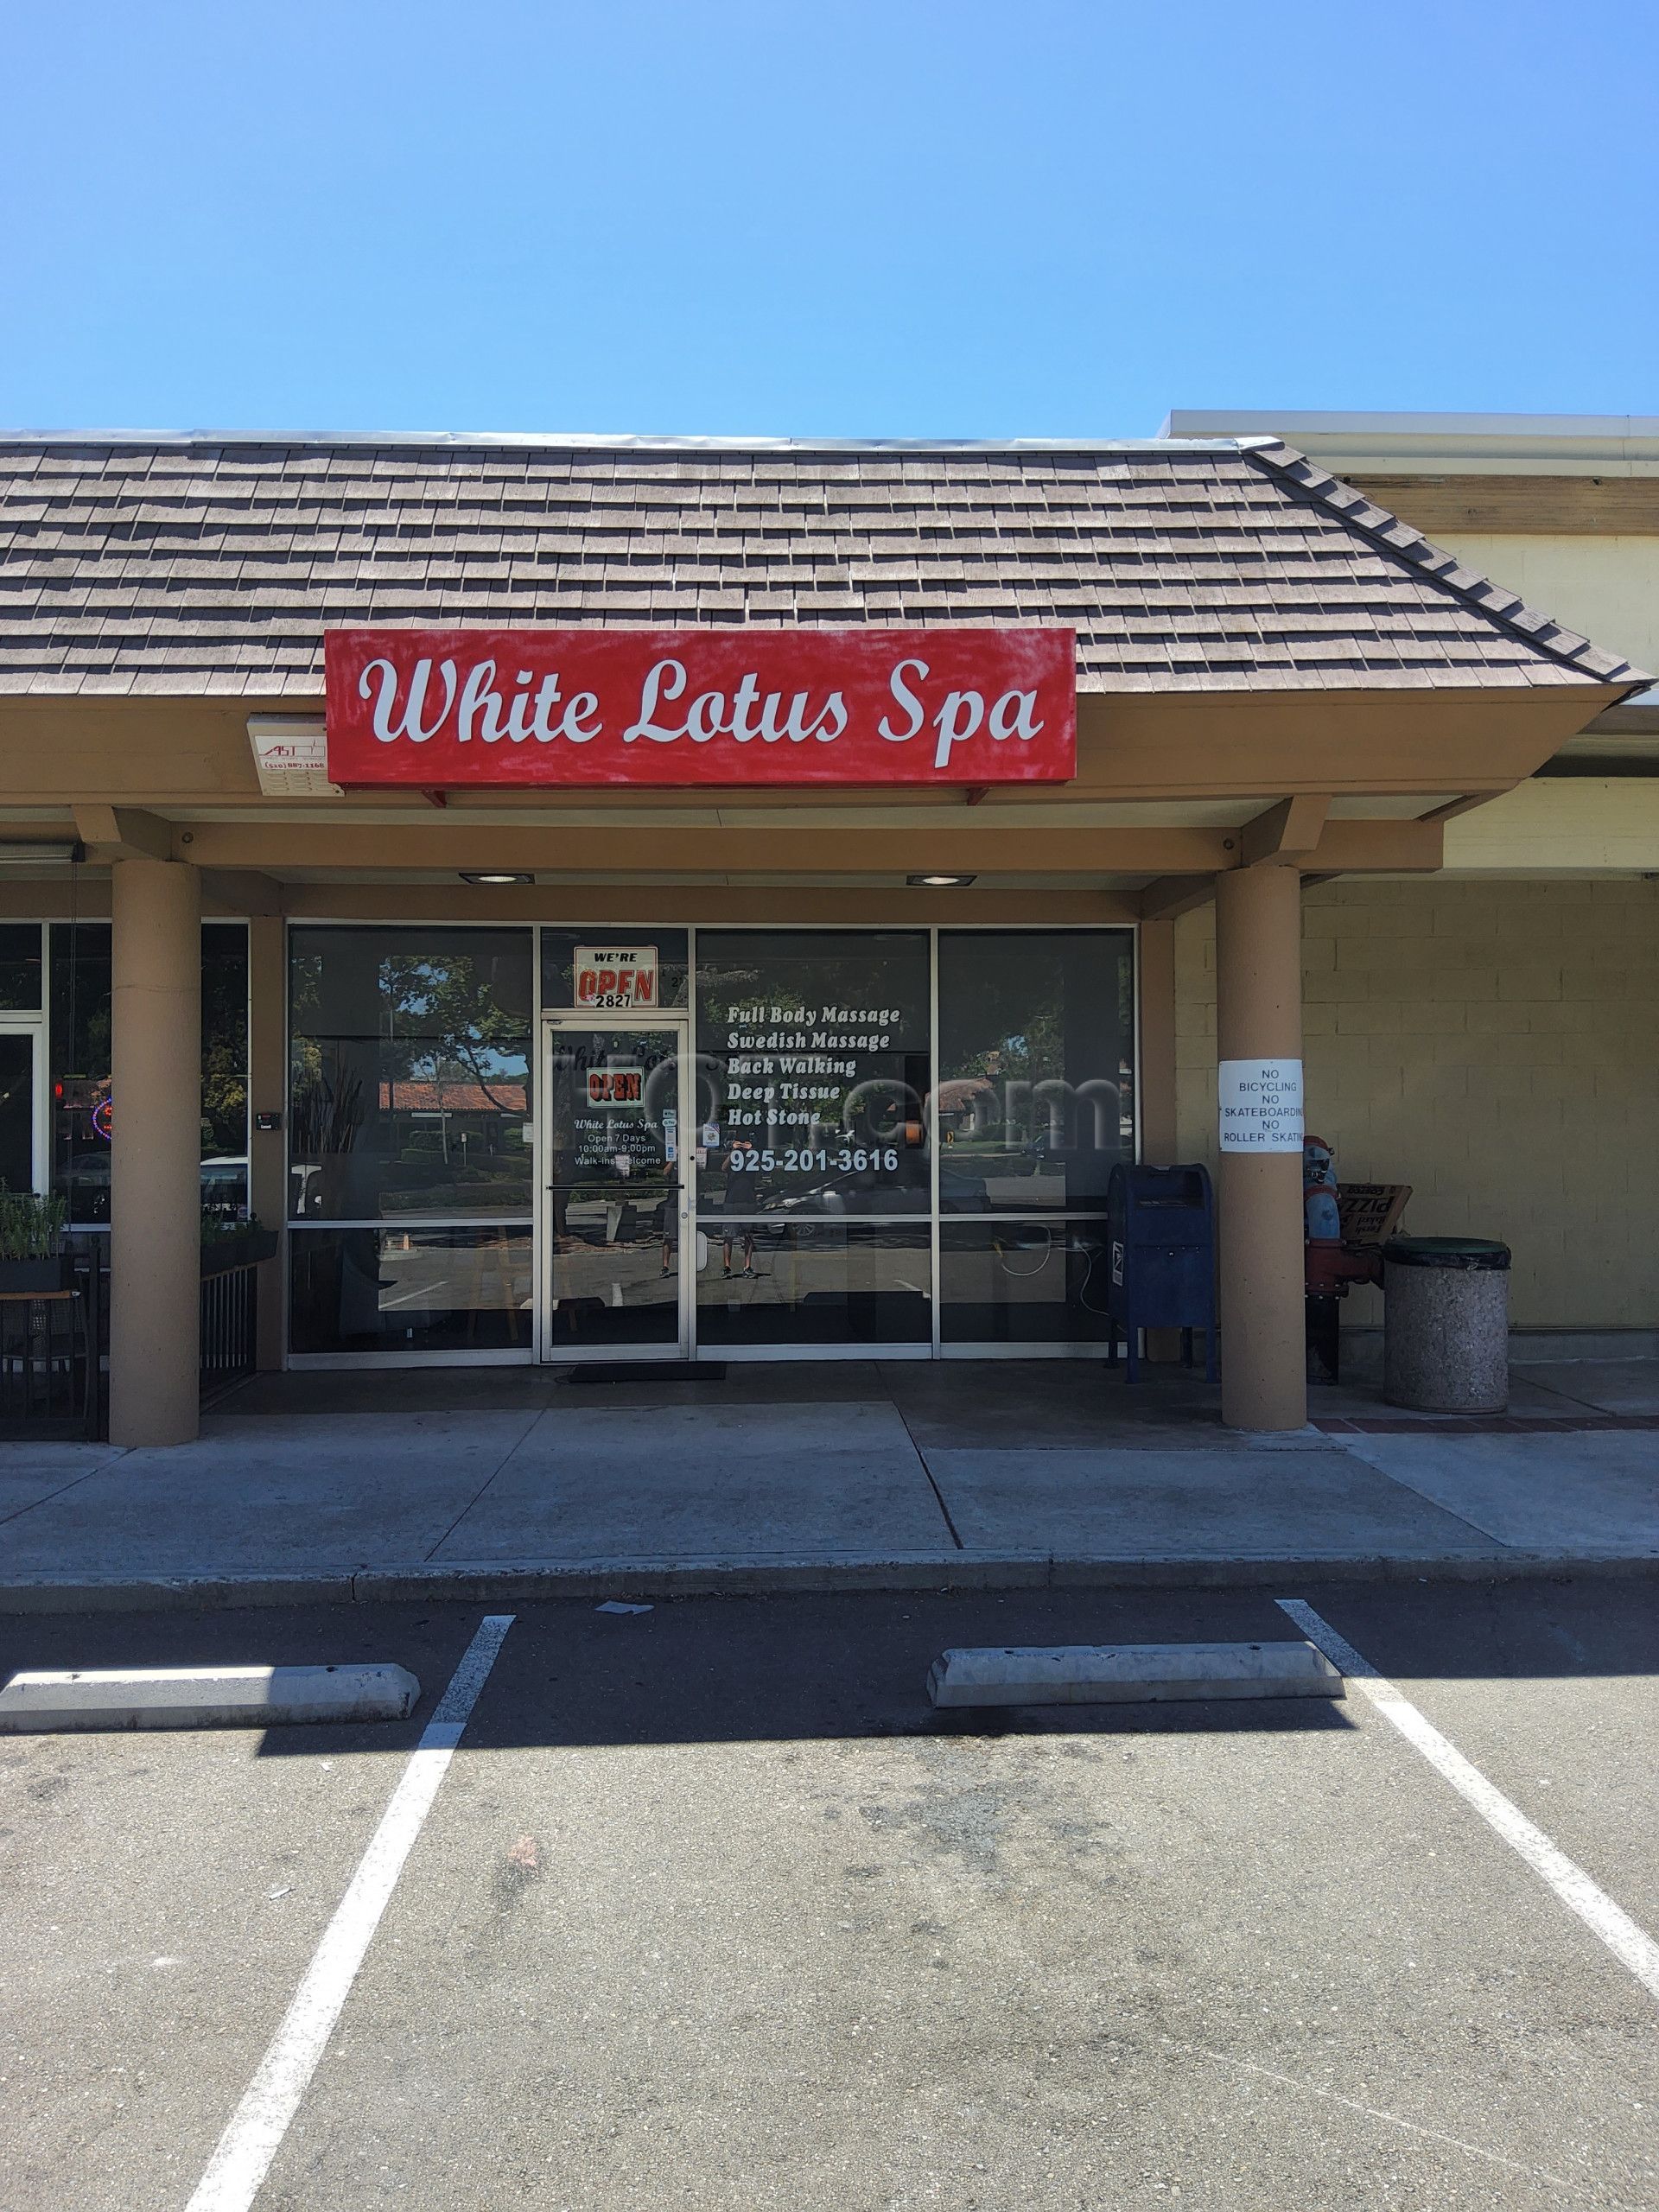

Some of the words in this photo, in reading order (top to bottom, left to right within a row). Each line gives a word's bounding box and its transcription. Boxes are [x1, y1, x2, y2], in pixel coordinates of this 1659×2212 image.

[359, 658, 603, 743] White
[623, 658, 849, 743] Lotus
[878, 658, 1045, 769] Spa
[594, 953, 638, 962] WE'RE
[579, 969, 654, 1001] OPEN
[595, 995, 631, 1007] 2827
[728, 1007, 765, 1023] Full
[770, 1007, 817, 1027] Body
[822, 1007, 900, 1026] Massage
[728, 1032, 806, 1049] Swedish
[810, 1033, 890, 1052] Massage
[728, 1058, 774, 1075] Back
[779, 1058, 856, 1077] Walking
[1262, 1070, 1279, 1079] NO
[589, 1073, 642, 1101] OPEN
[1239, 1082, 1297, 1091] BICYCLING
[728, 1084, 775, 1103] Deep
[780, 1083, 840, 1099] Tissue
[1262, 1095, 1279, 1104] NO
[728, 1109, 762, 1126] Hot
[766, 1109, 821, 1125] Stone
[1224, 1108, 1303, 1116] SKATEBOARDIN
[575, 1119, 604, 1129] White
[607, 1119, 634, 1129] Lotus
[638, 1119, 658, 1131] Spa
[1262, 1120, 1280, 1130] NO
[588, 1135, 613, 1144] Open
[623, 1135, 646, 1143] Days
[1224, 1132, 1266, 1142] ROLLER
[1271, 1132, 1303, 1142] SKATIN
[579, 1145, 656, 1154] 10:00am-9:00pm
[729, 1148, 899, 1172] 925-201-3616
[1342, 1196, 1395, 1213] PIZZ
